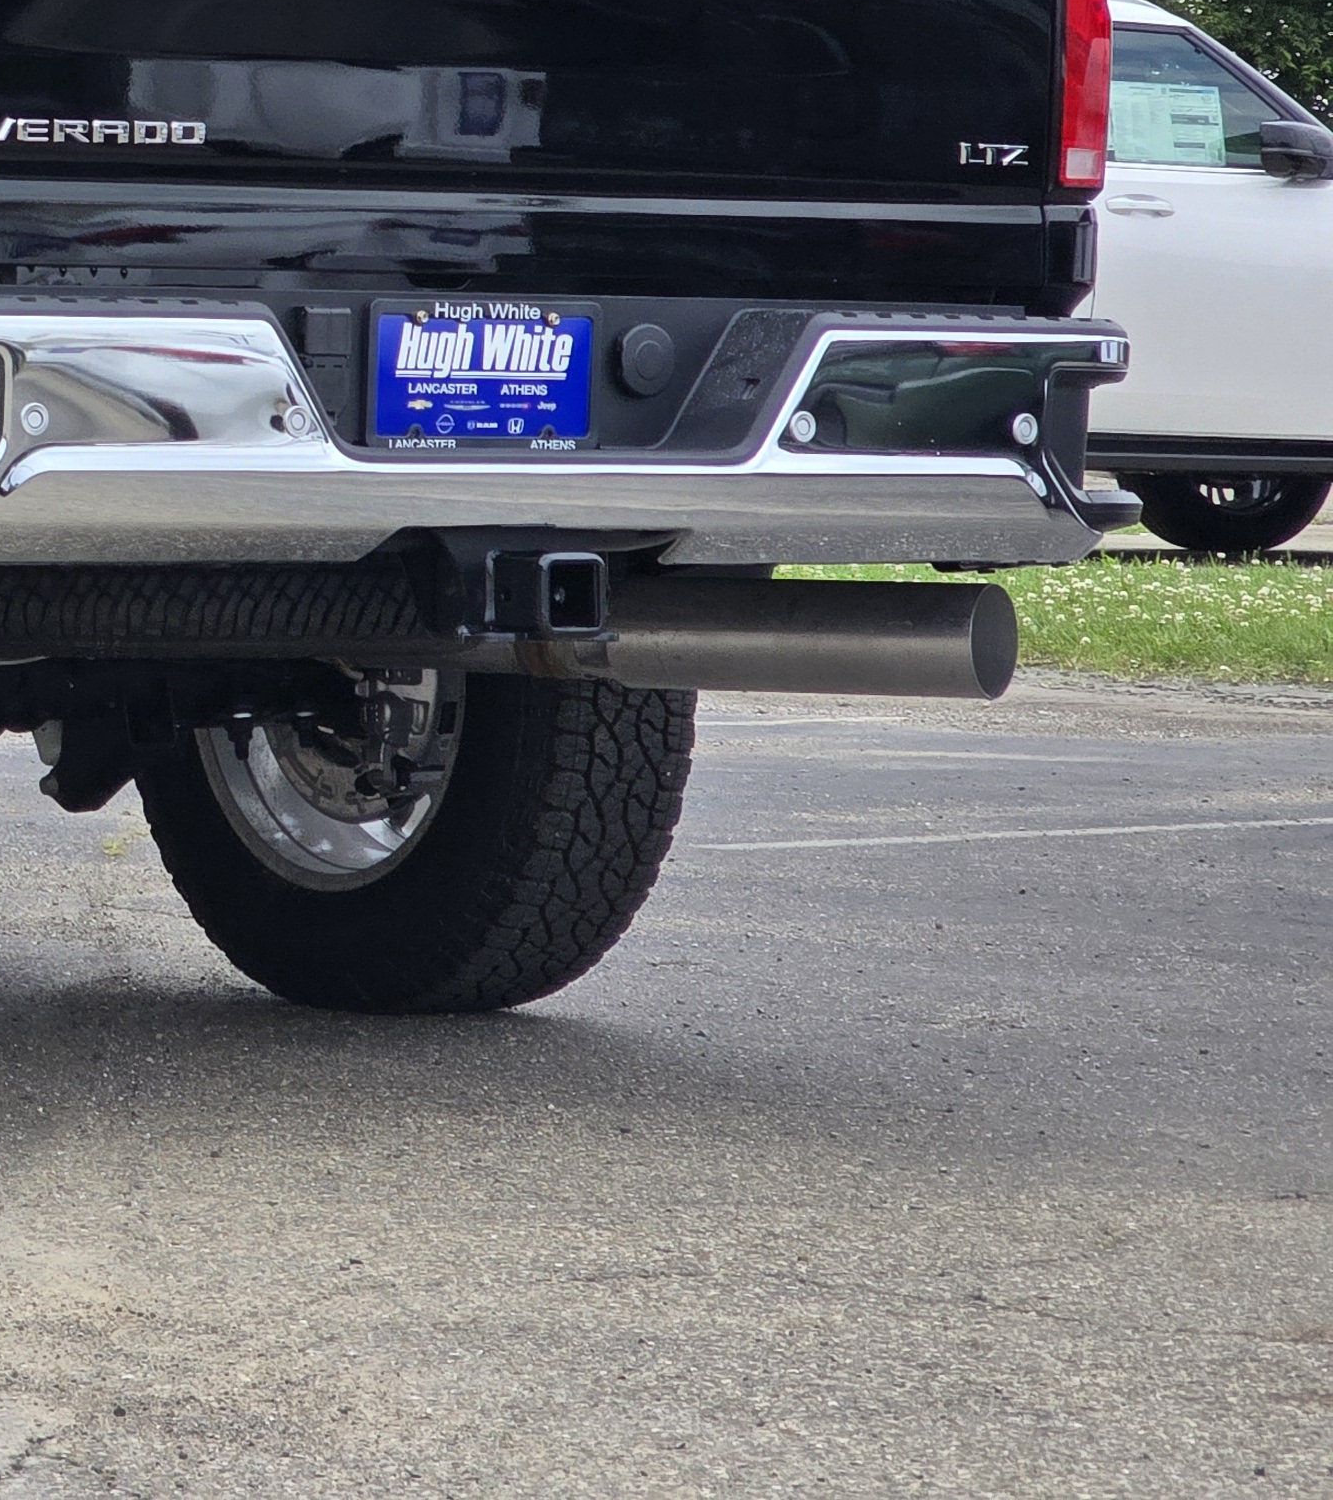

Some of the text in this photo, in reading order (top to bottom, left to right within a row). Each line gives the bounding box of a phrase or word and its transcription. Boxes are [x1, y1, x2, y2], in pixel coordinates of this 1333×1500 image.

[959, 141, 1030, 167] LTZ
[434, 302, 542, 323] Hugh White
[396, 322, 574, 379] Hugh White
[408, 382, 549, 396] LANCASTER ATHENS
[530, 439, 577, 451] ATHENS
